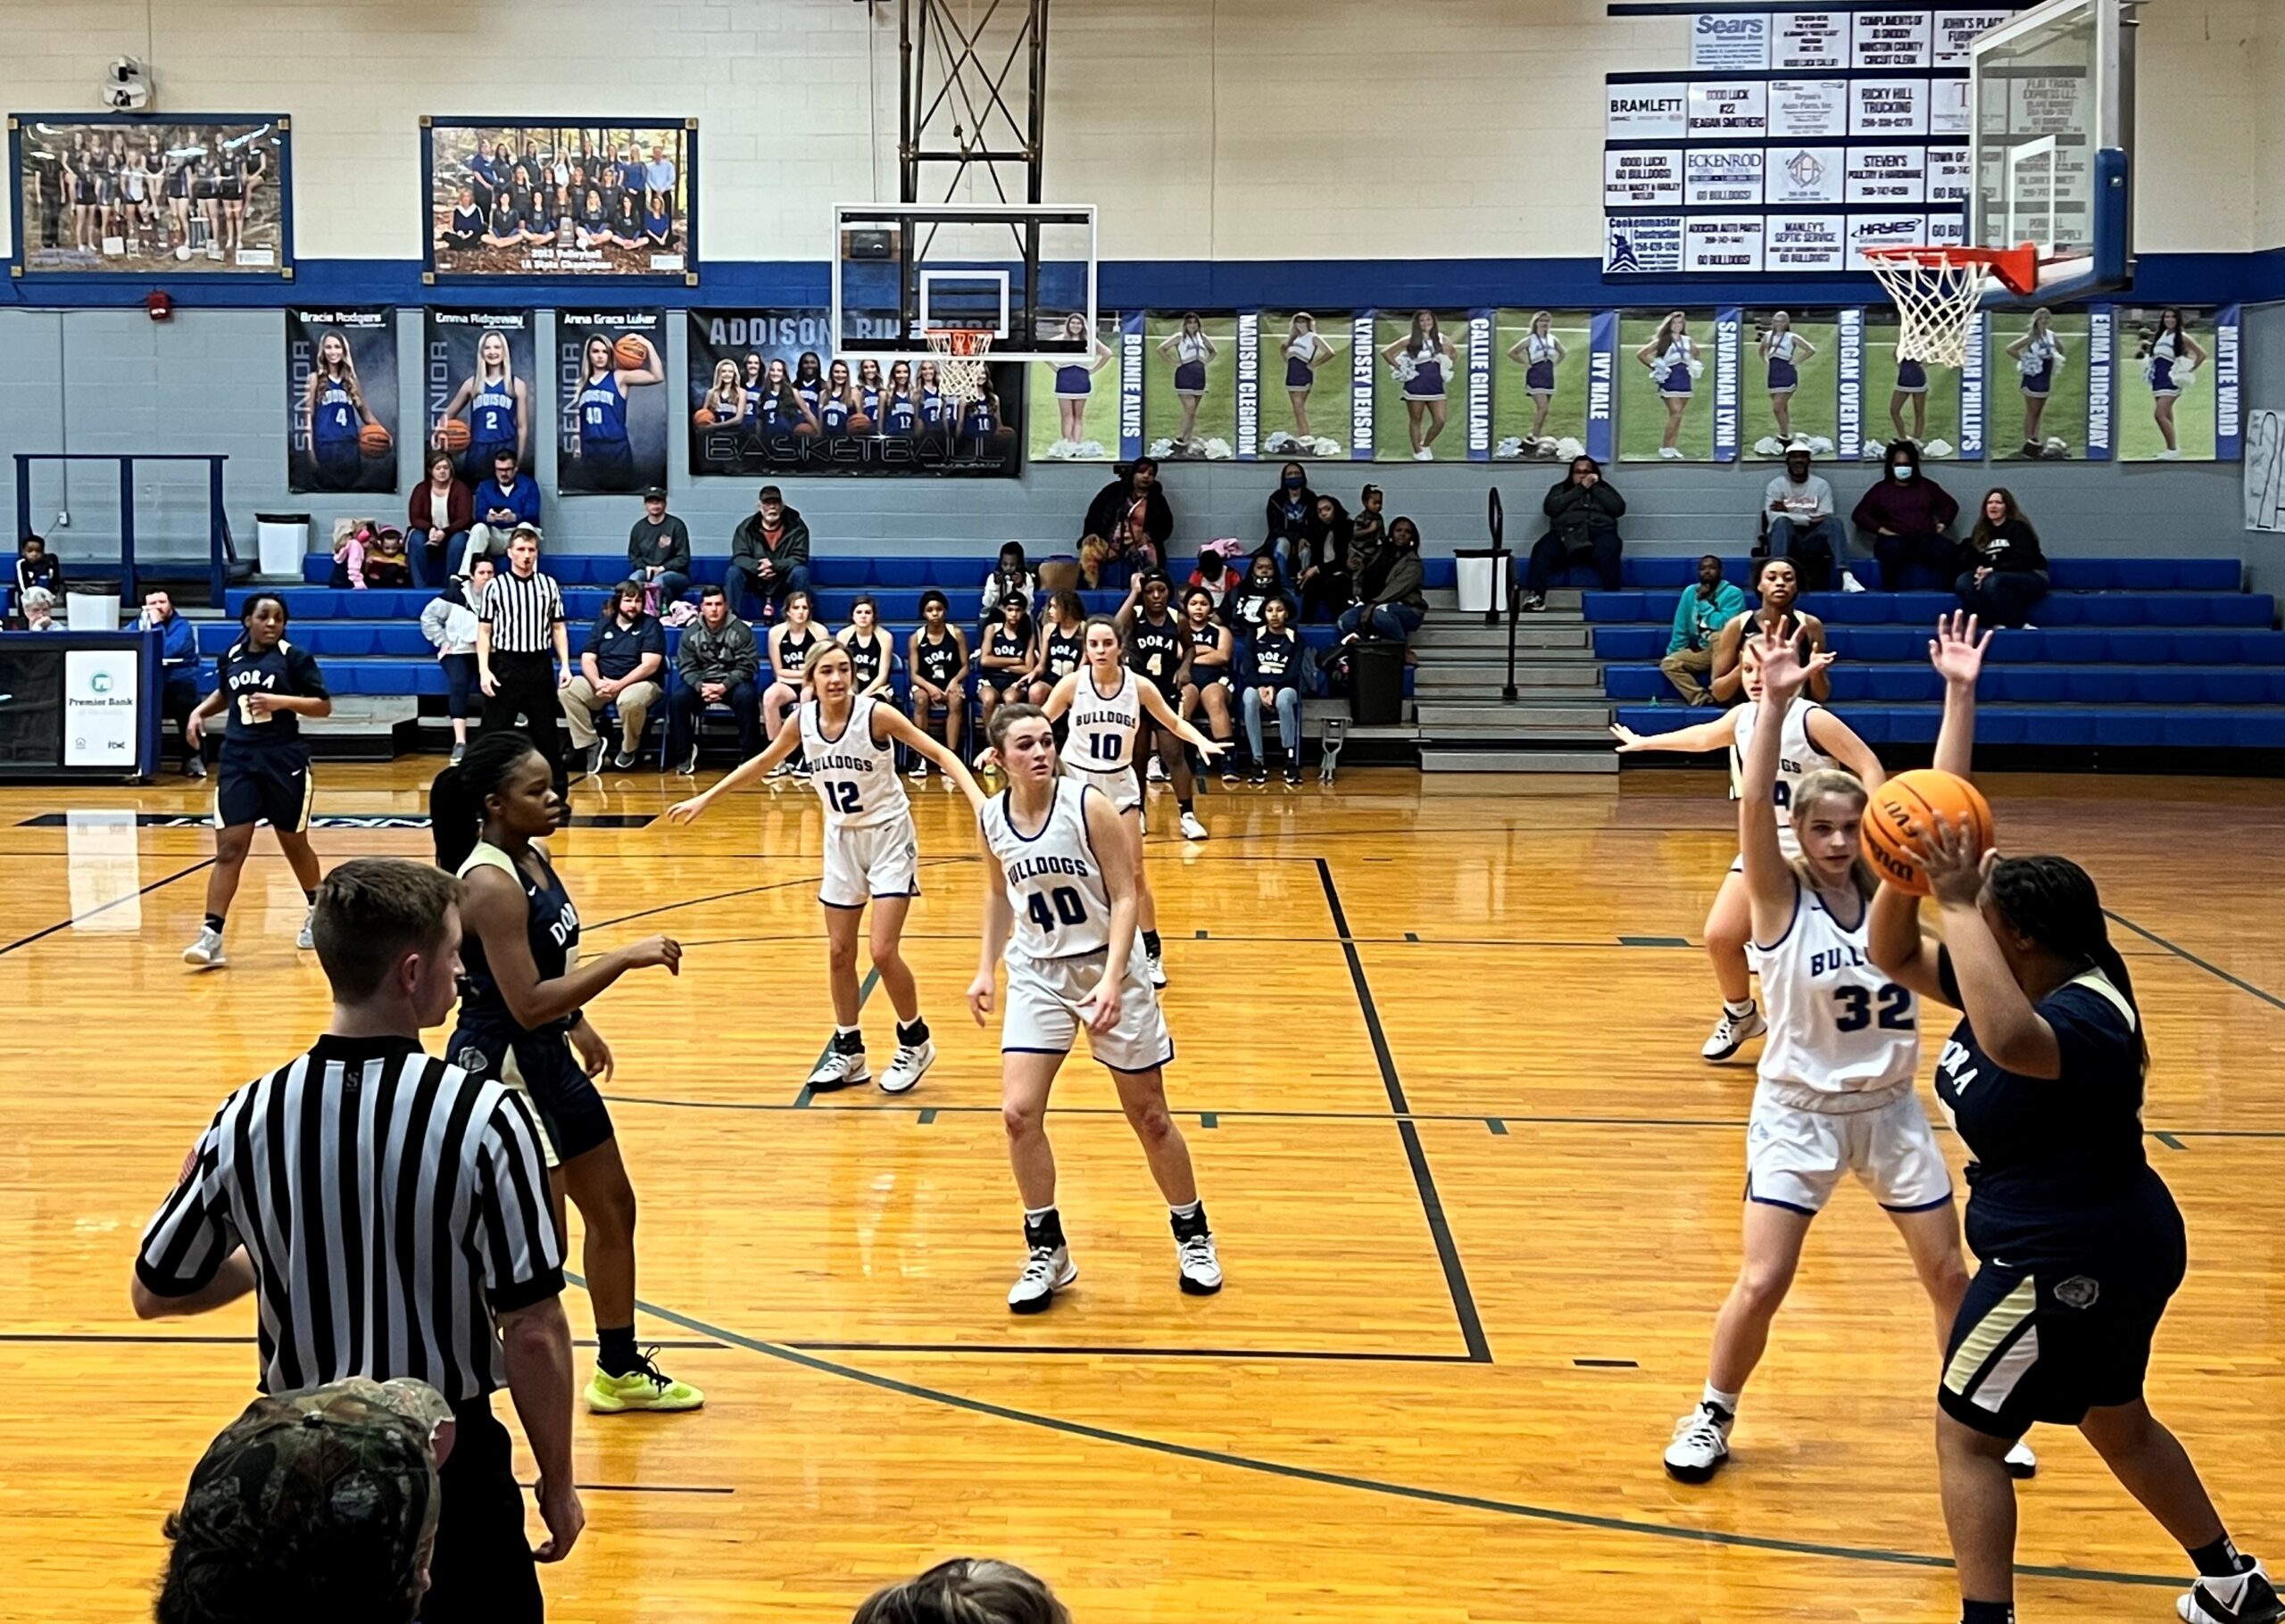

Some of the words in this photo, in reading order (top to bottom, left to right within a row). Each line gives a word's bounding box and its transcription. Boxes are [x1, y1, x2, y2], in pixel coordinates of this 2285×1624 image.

[1697, 15, 1764, 34] Sears
[1942, 18, 1973, 29] JOHN'S
[1894, 42, 1924, 51] COUNTY
[1729, 89, 1749, 100] LUCK
[1861, 88, 1890, 100] RICKY
[1893, 87, 1914, 99] HILL
[1610, 99, 1683, 112] BRAMLETT
[1864, 101, 1912, 113] TRUCKING
[1620, 157, 1641, 167] GOOD
[1688, 153, 1762, 168] ECKENROD
[1864, 155, 1907, 168] STEVEN'S
[1616, 170, 1626, 179] GO
[1628, 169, 1671, 179] BULLDOGS!
[1709, 190, 1751, 201] BULLDOGS!
[1933, 187, 1946, 199] GO
[1720, 223, 1738, 232] AUTO
[1740, 223, 1761, 232] PARTS
[1785, 222, 1824, 232] MANLEY'S
[1859, 220, 1916, 235] HAYES
[1932, 225, 1946, 236] GO
[1775, 233, 1802, 243] SEPTIC
[1804, 232, 1836, 243] SERVICE
[534, 260, 559, 269] State
[561, 260, 613, 270] Champions
[1698, 255, 1708, 265] GO
[1709, 255, 1750, 265] BULLDOGS!
[336, 312, 382, 325] Rodgers
[436, 313, 469, 324] Emma
[470, 314, 523, 327] Ridgeway
[564, 315, 591, 325] Anna
[593, 314, 625, 325] Grace
[627, 314, 657, 325] Luker
[710, 317, 832, 345] ADDISON
[2090, 313, 2111, 363] EMMA
[1239, 314, 1257, 379] MADISON
[1354, 318, 1373, 385] LYNDSEY
[1470, 318, 1490, 369] CALLIE
[1840, 310, 1860, 379] MORGAN
[1123, 334, 1142, 392] BONNIE
[1591, 352, 1611, 378] IVY
[1716, 320, 1737, 405] SAVANNAH
[2218, 326, 2239, 385] MATTIE
[292, 341, 312, 451] SENIOR
[430, 341, 448, 451] SENIOR
[563, 343, 580, 454] SENIOR
[1590, 382, 1610, 420] HALE
[586, 408, 602, 425] 40
[1123, 394, 1140, 438] ALVIS
[1469, 371, 1489, 450] GILLILAND
[1961, 381, 1982, 452] PHILLIPS
[2089, 366, 2109, 449] RIDGEWAY
[2219, 386, 2239, 436] WARD
[336, 408, 347, 427] 4
[486, 412, 497, 429] 2
[1238, 381, 1257, 454] CLEGHORN
[1353, 387, 1372, 449] DENSON
[1840, 382, 1859, 455] OVERTON
[1716, 408, 1736, 447] LYNN
[705, 434, 1006, 463] BASKETBALL
[1137, 635, 1173, 650] DORA
[1192, 634, 1213, 644] ORA
[783, 651, 803, 663] DOR
[925, 650, 952, 665] DORA
[1051, 645, 1077, 659] DORA
[1257, 651, 1288, 663] DORA
[1146, 653, 1161, 676] 4
[228, 669, 275, 691] DORA
[69, 698, 106, 706] Premier
[109, 697, 133, 706] Bank
[1076, 710, 1136, 729] BULLDOGS
[1089, 733, 1122, 761] 10
[824, 781, 863, 814] 12
[1027, 886, 1088, 933] 40
[550, 902, 578, 946] DOR
[1834, 983, 1915, 1032] 32
[1940, 1040, 1978, 1096] ORA
